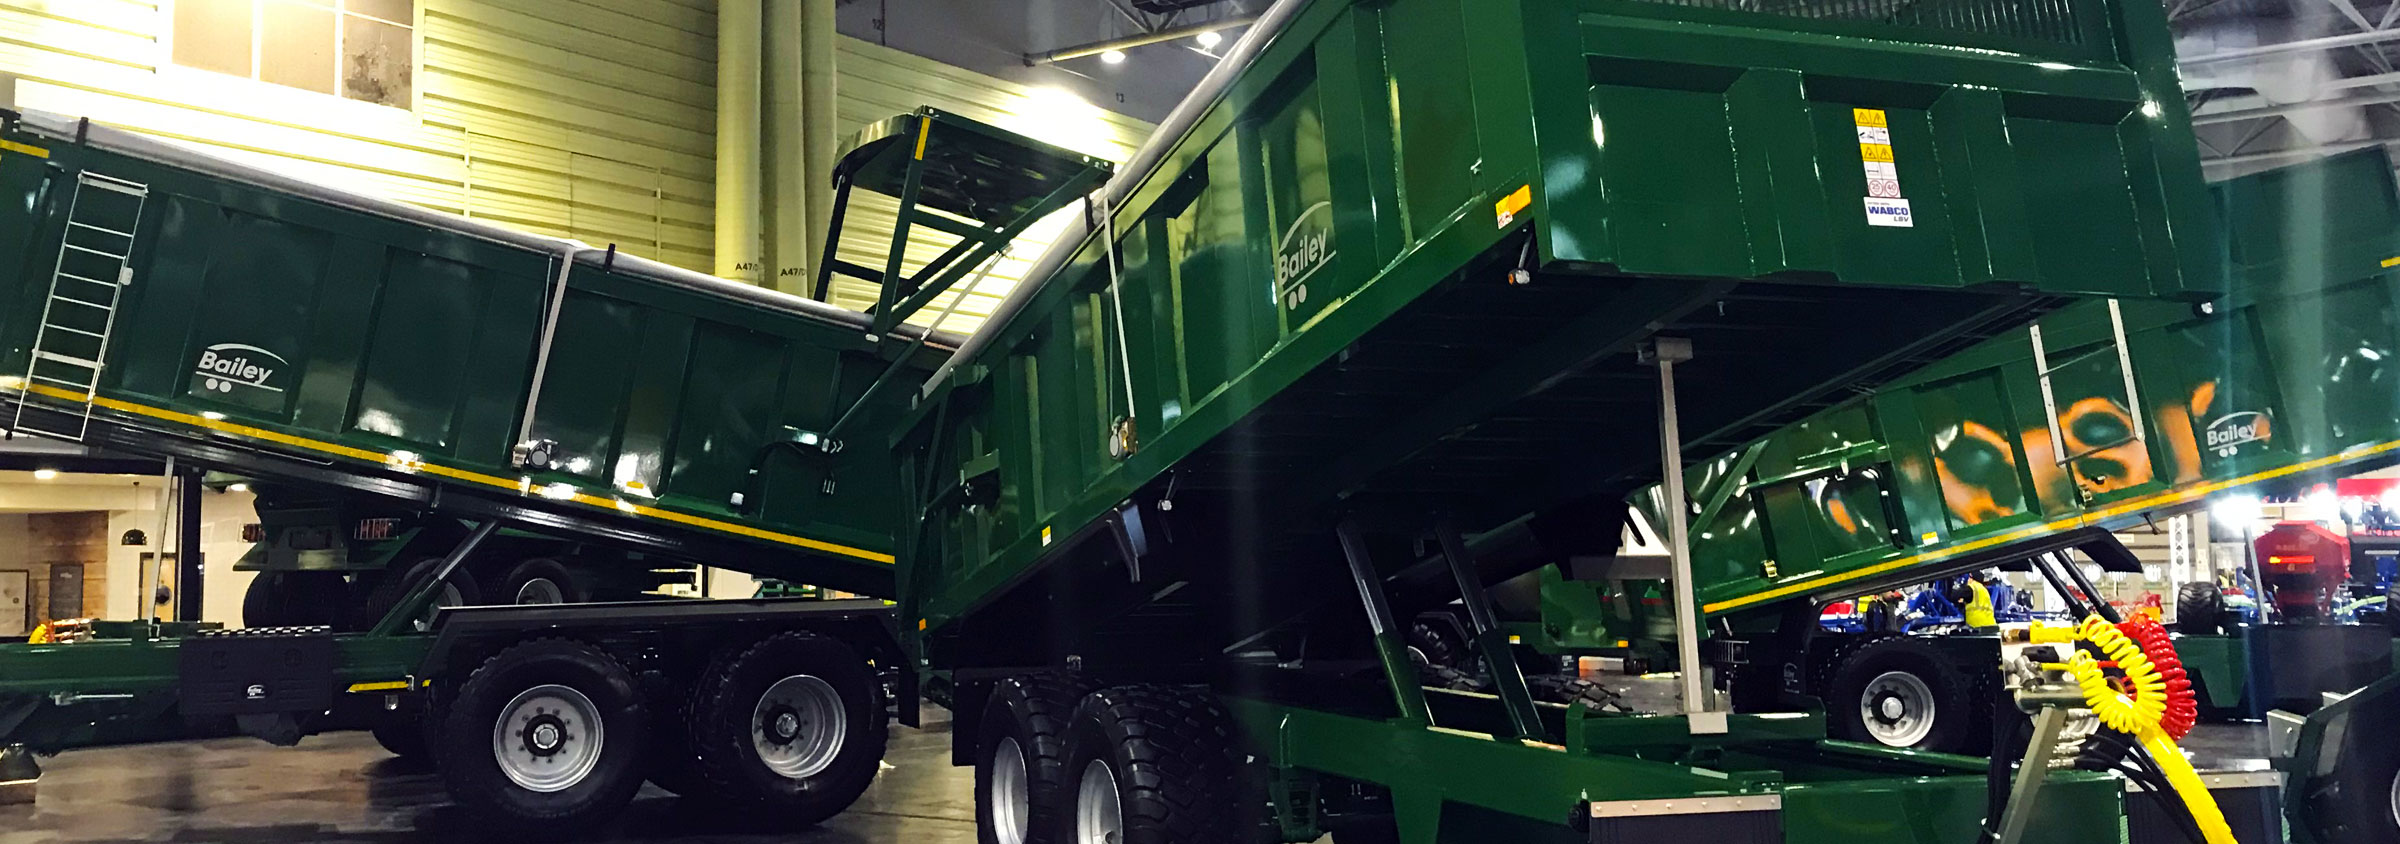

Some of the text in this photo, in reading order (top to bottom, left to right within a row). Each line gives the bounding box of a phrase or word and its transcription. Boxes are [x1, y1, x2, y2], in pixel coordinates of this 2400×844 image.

[1867, 206, 1909, 216] WABCO
[1278, 227, 1327, 288] Bailey
[198, 350, 273, 385] Bailey
[2206, 424, 2258, 446] Bailey
